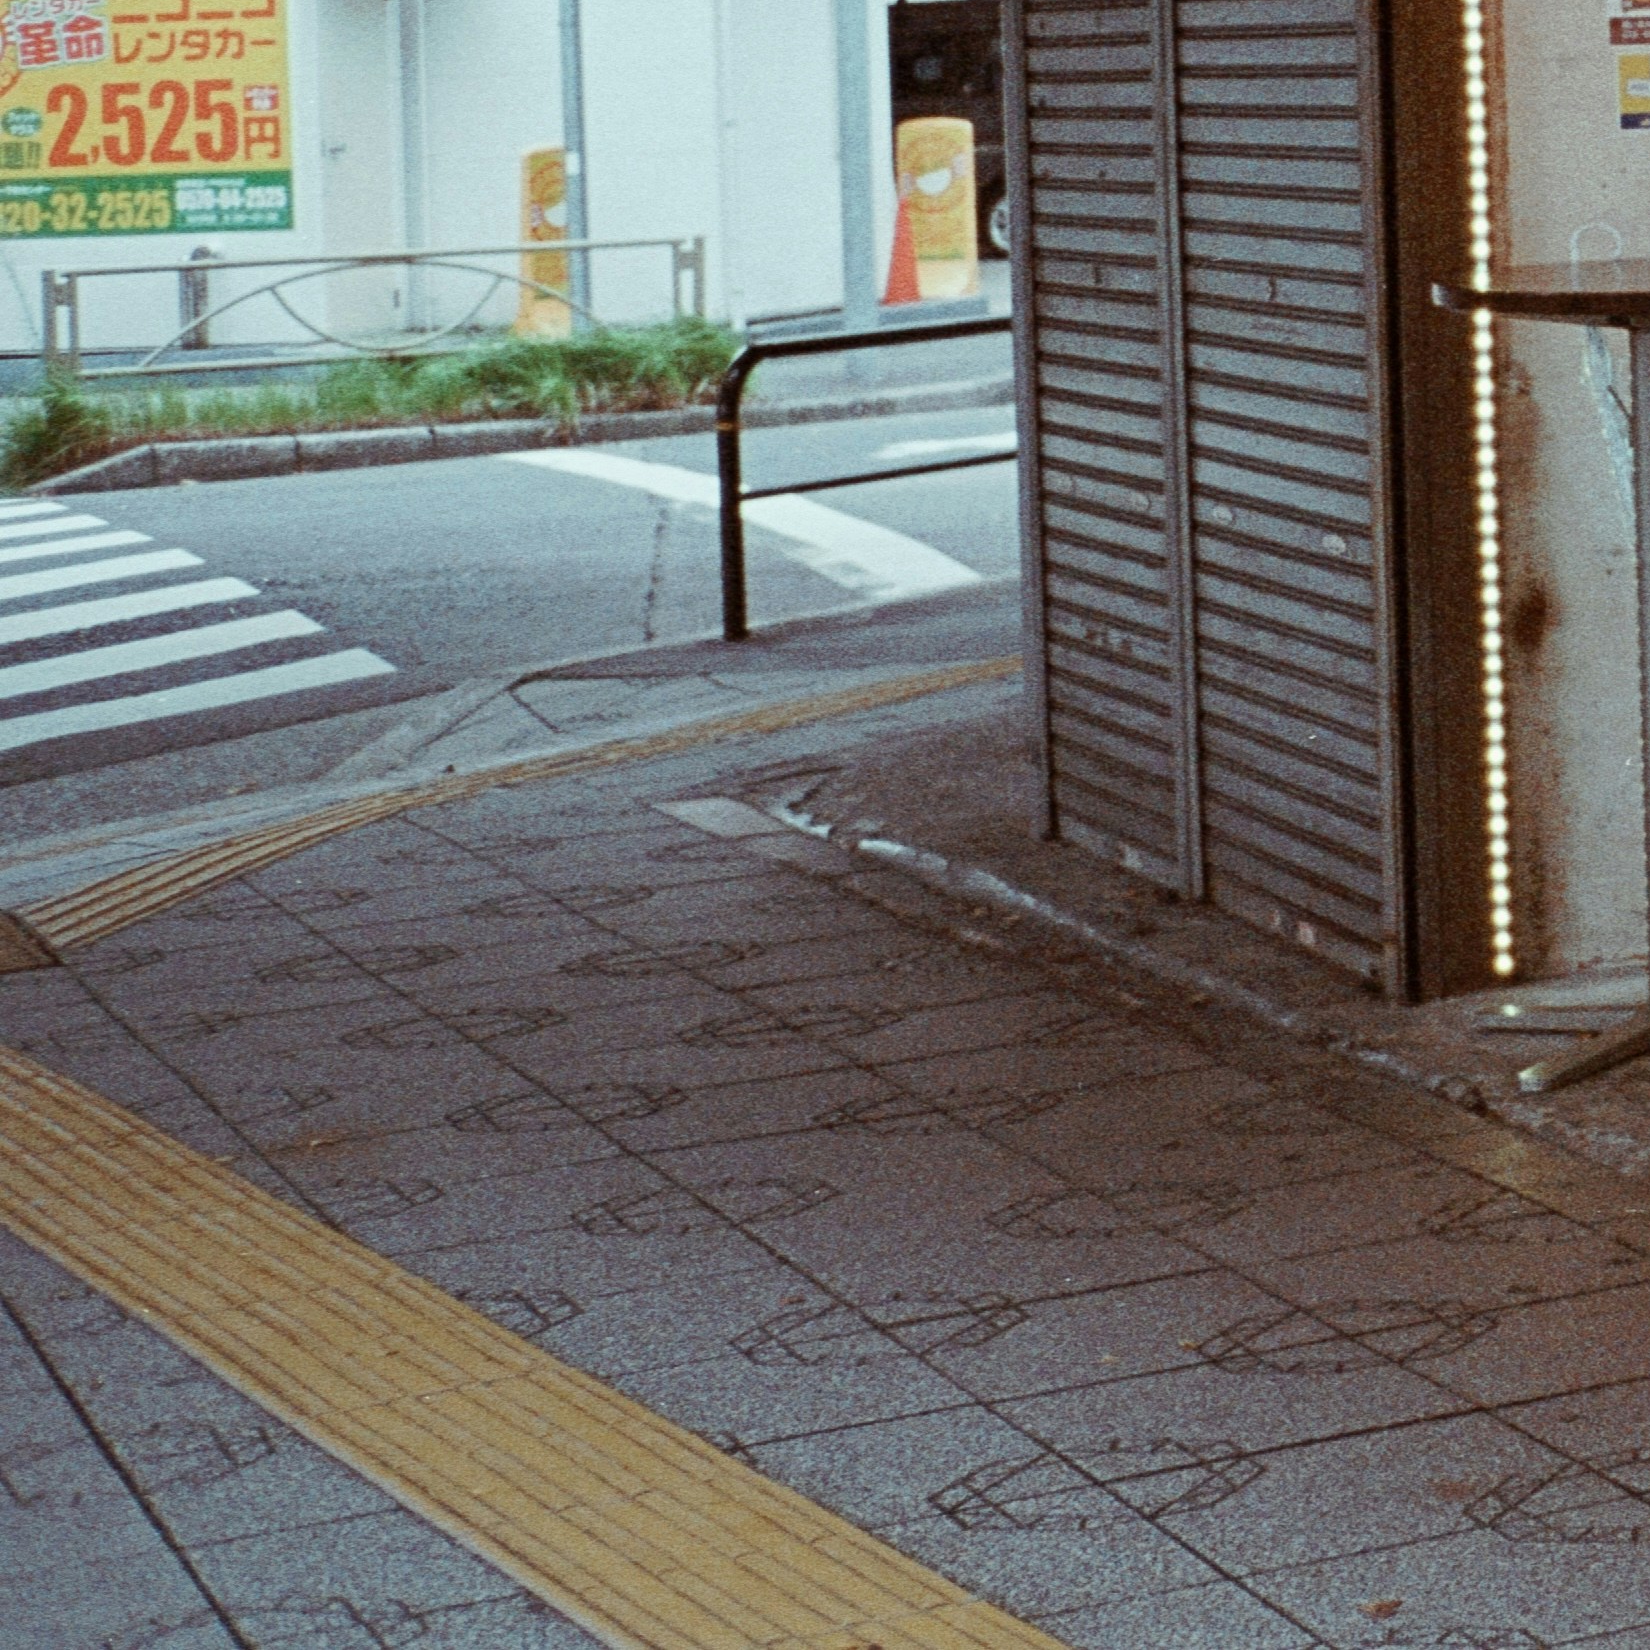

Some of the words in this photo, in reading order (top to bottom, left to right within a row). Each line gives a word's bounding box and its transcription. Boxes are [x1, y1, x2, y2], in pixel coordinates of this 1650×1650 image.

[18, 15, 105, 66] 革命
[113, 28, 277, 64] レンタカー
[46, 78, 239, 168] 2,525
[243, 116, 282, 161] 円
